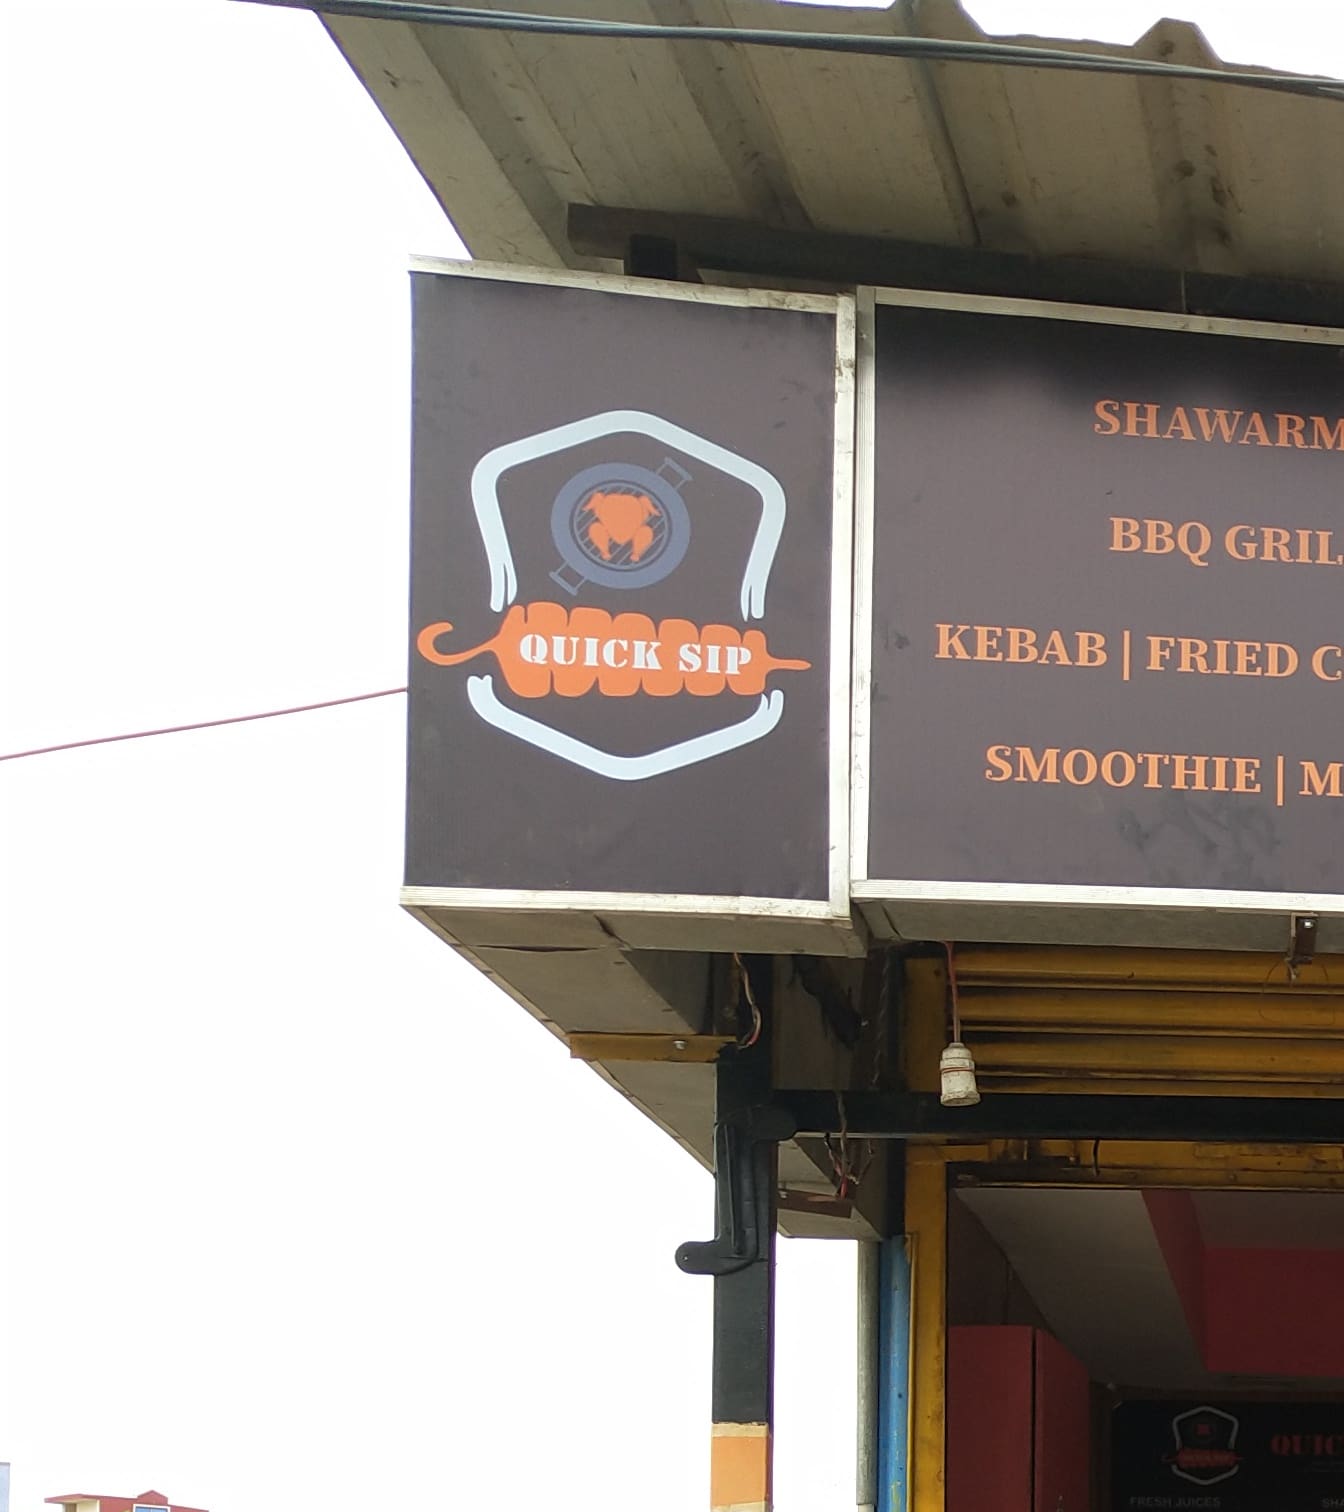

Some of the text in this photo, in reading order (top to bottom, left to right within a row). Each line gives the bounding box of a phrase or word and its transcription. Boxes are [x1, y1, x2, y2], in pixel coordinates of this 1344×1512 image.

[1110, 516, 1212, 567] BBQ
[519, 633, 753, 678] QUICK SIP
[936, 622, 1109, 668] KEBAB
[1147, 635, 1299, 679] FRIED
[984, 744, 1262, 795] SMOOTHIE
